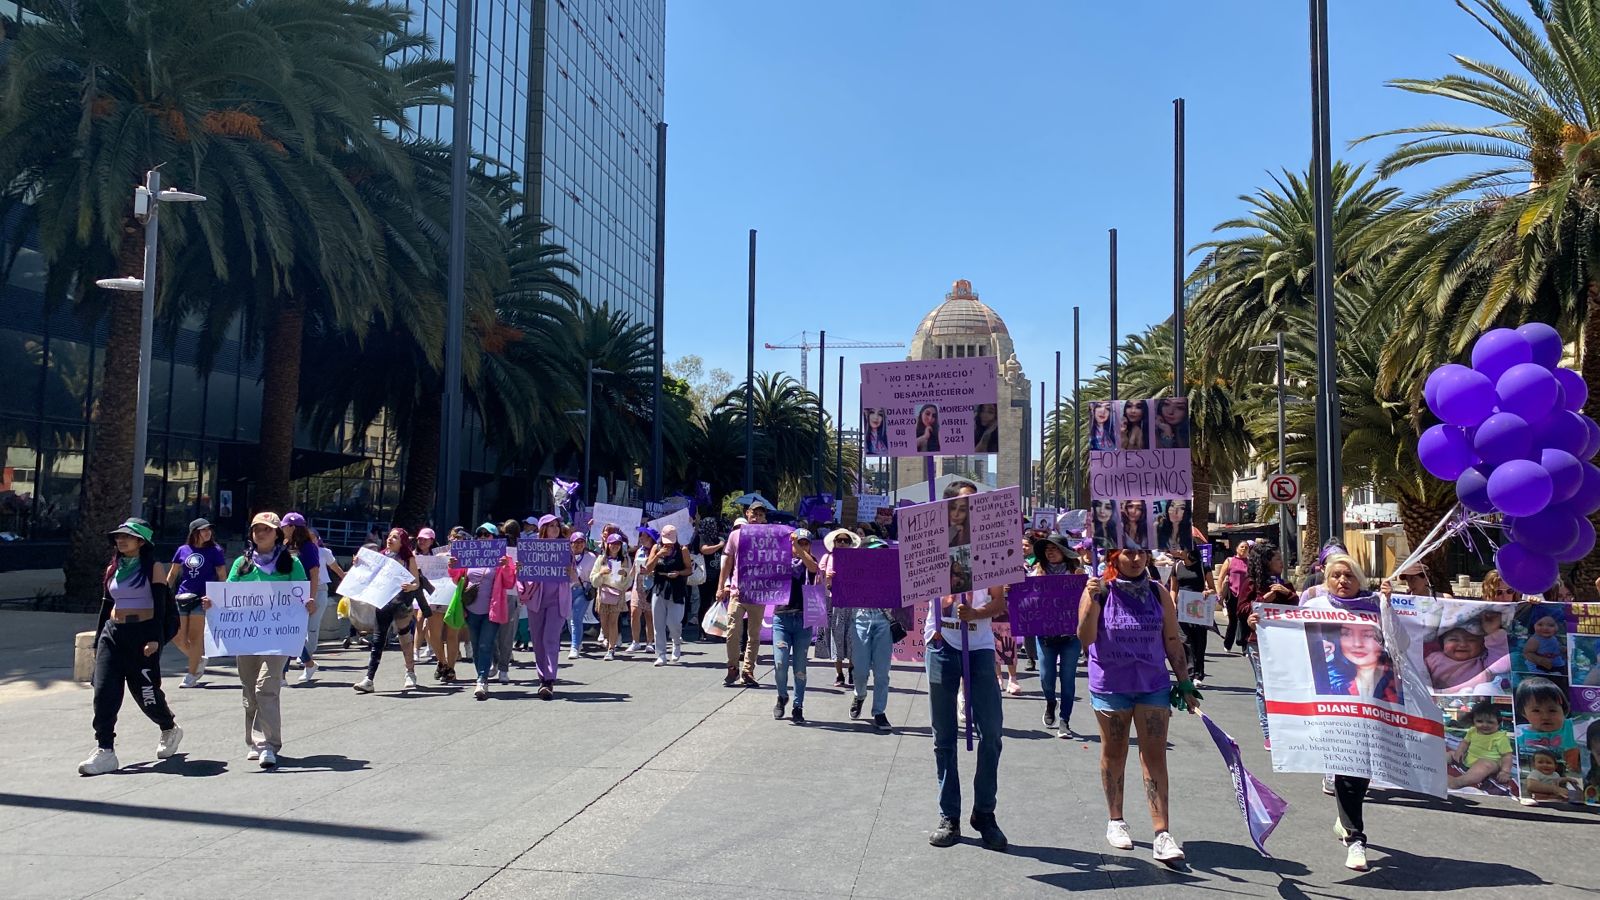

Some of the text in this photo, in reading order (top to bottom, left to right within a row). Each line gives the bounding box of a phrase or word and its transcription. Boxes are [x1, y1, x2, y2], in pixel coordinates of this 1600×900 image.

[894, 388, 974, 400] DESAPARECIERON
[886, 405, 974, 416] DIANE MORENO
[888, 418, 968, 426] MARZO ABRIL
[1091, 450, 1176, 470] HOY ES SU
[974, 496, 990, 505] HOY
[976, 500, 1016, 513] CUMPLES
[904, 526, 945, 543] MIENTRAS
[452, 541, 492, 550] ELLA ES TAN
[517, 542, 570, 552] DESOBEDIENTE
[751, 538, 780, 549] ROPA
[911, 539, 936, 550] NO TE
[458, 549, 500, 558] FUERTE COMO
[758, 550, 779, 562] FUE
[904, 546, 941, 561] ENTIERRE
[905, 561, 914, 569] TE
[908, 561, 950, 577] BUSCANDO
[519, 566, 567, 577] PRESIDENTE
[913, 576, 936, 588] DIANE
[1392, 598, 1414, 606] NOL
[249, 610, 265, 622] NO
[272, 612, 281, 622] se
[1264, 608, 1281, 620] TE
[1285, 609, 1356, 621] SEGUIMOS
[244, 626, 258, 638] NO
[263, 628, 272, 636] se
[275, 624, 300, 636] violan
[141, 685, 156, 706] NIKE
[1317, 704, 1408, 725] DIANE MORENO
[1332, 745, 1357, 754] blanca
